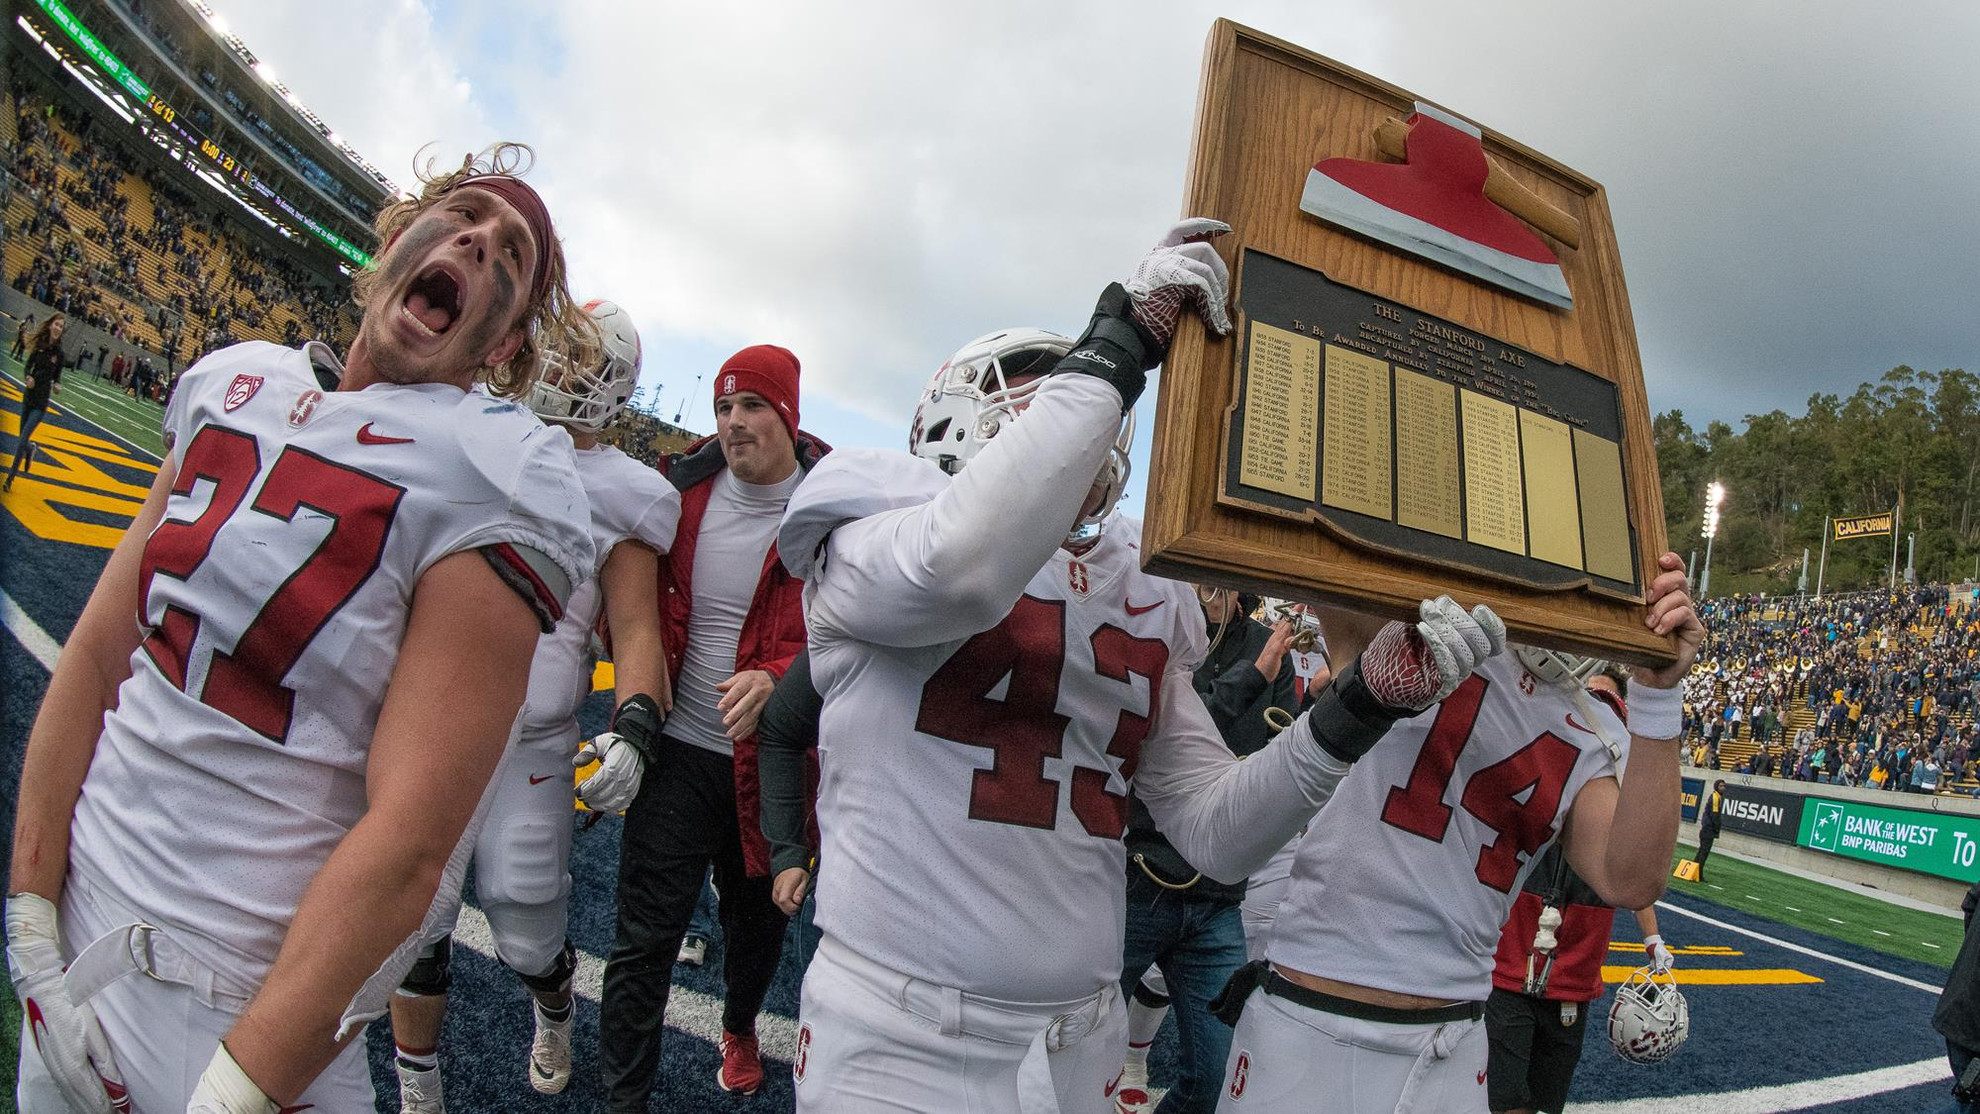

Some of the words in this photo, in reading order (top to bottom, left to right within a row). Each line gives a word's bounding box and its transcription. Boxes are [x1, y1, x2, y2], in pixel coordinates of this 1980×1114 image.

[164, 107, 175, 123] 13
[201, 140, 220, 160] 0:00
[222, 156, 234, 171] 23
[1267, 335, 1291, 347] STANFORD
[1374, 303, 1401, 323] THE
[1418, 319, 1485, 351] STANFORD
[1500, 350, 1526, 368] AXE
[1409, 328, 1439, 344] FORGED
[1446, 342, 1473, 356] MARCH
[1267, 342, 1291, 354] STANFORD
[1360, 322, 1402, 340] CAPTURED
[1428, 345, 1474, 366] CALIFORNIA
[1482, 365, 1505, 378] APRIL
[1266, 355, 1292, 368] CALIFORNIA
[1267, 349, 1290, 361] STANFORD
[1359, 331, 1413, 354] RECAPTURED
[1419, 351, 1428, 360] BY
[1437, 358, 1475, 376] STANFORD
[1484, 374, 1506, 387] APRIL
[1266, 362, 1292, 374] CALIFORNIA
[1265, 369, 1291, 382] CALIFORNIA
[1265, 376, 1291, 388] CALIFORNIA
[1262, 389, 1289, 402] CALIFORNIA
[1264, 383, 1288, 395] STANFORD
[1264, 396, 1288, 408] STANFORD
[1263, 404, 1287, 416] STANFORD
[1263, 411, 1289, 423] CALIFORNIA
[1262, 418, 1289, 431] CALIFORNIA
[1262, 426, 1289, 439] CALIFORNIA
[1259, 440, 1286, 452] CALIFORNIA
[1271, 436, 1284, 444] GAME
[1260, 448, 1288, 460] CALIFORNIA
[1259, 463, 1287, 475] CALIFORNIA
[1270, 458, 1283, 467] GAME
[1259, 470, 1284, 482] STANFORD
[1838, 516, 1890, 536] CALIFORNIA
[136, 423, 408, 745] 27
[915, 593, 1169, 840] 43
[1381, 671, 1581, 894] 14
[1722, 798, 1784, 826] NISSAN
[1845, 816, 1884, 837] BANK
[1885, 822, 1894, 830] OF
[1882, 830, 1894, 840] THE
[1896, 823, 1938, 846] WEST
[1842, 835, 1863, 849] BNP
[1863, 841, 1907, 858] PARIBAS
[1681, 862, 1691, 876] G
